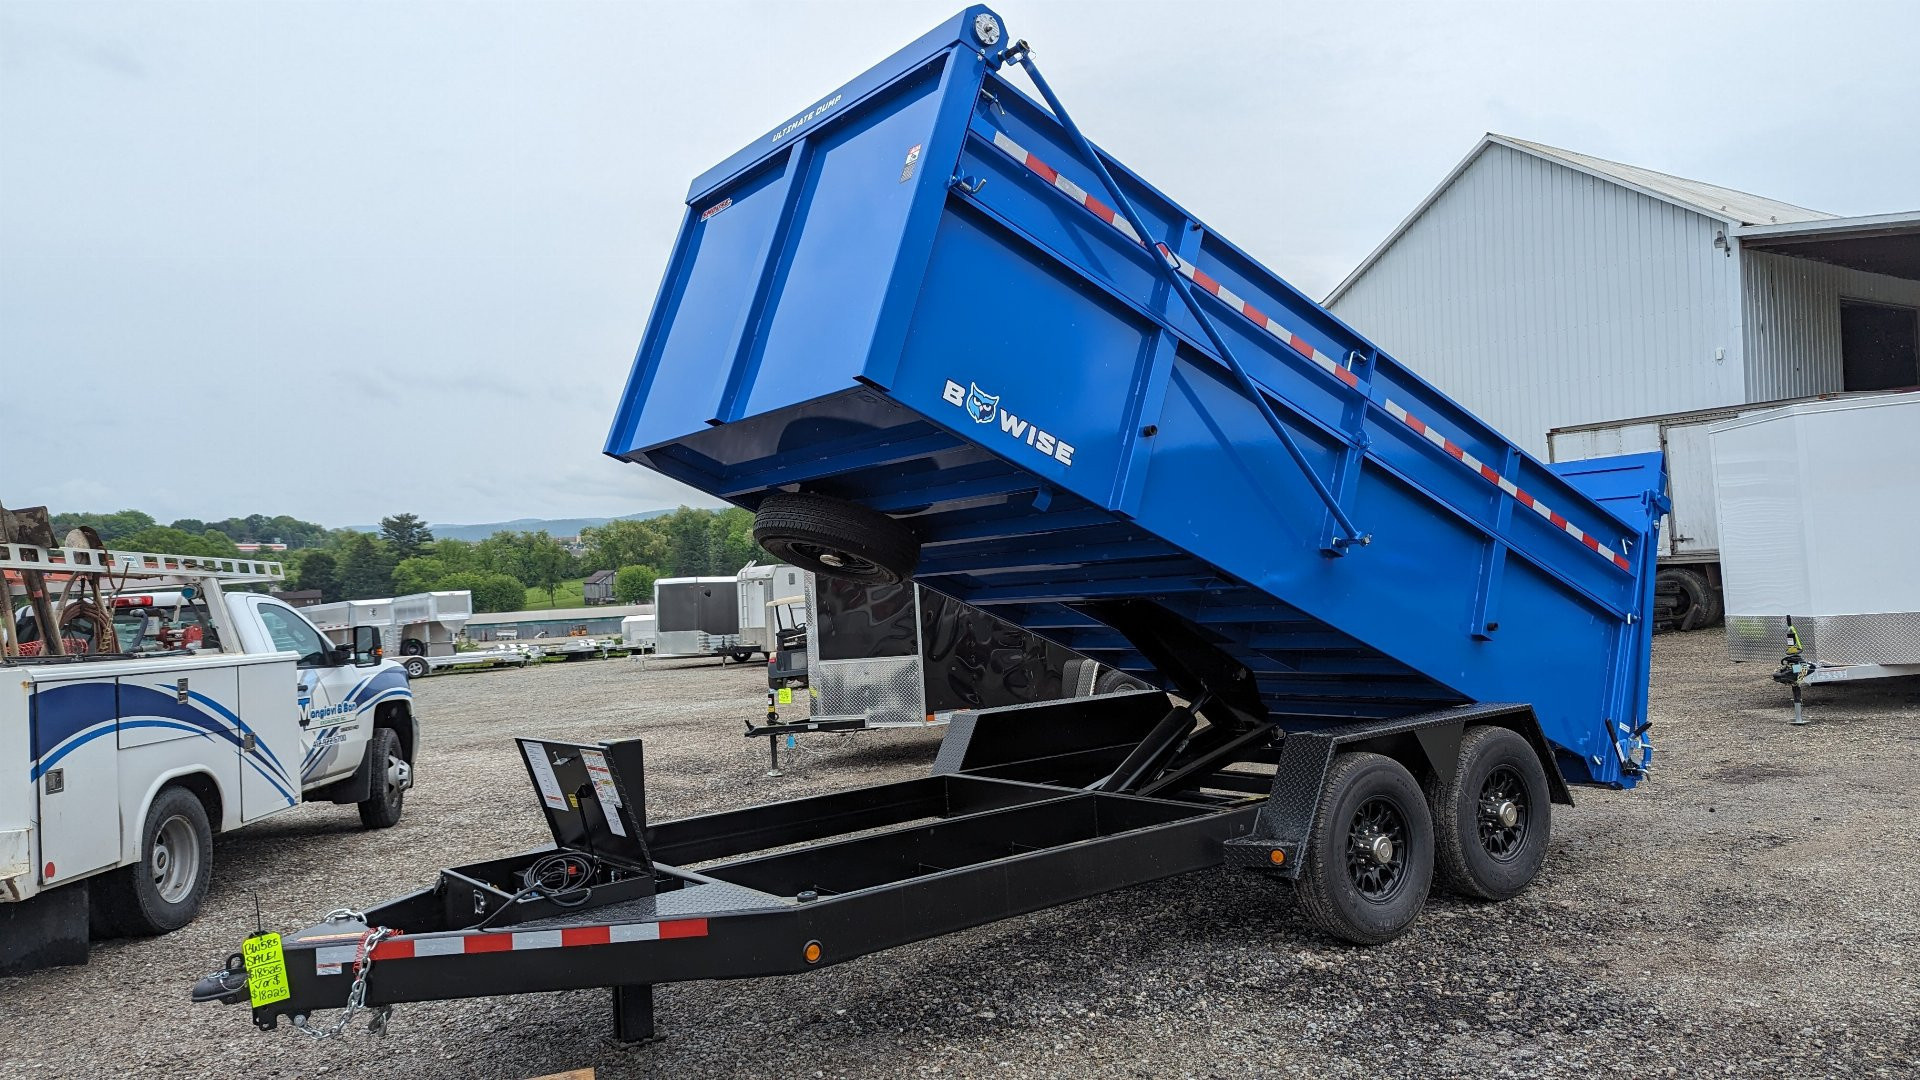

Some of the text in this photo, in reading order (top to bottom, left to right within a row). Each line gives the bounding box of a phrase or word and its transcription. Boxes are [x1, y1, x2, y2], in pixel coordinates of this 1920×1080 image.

[772, 94, 842, 142] ULTIMATE DUMP
[337, 703, 343, 714] &
[251, 986, 288, 1001] $18225
